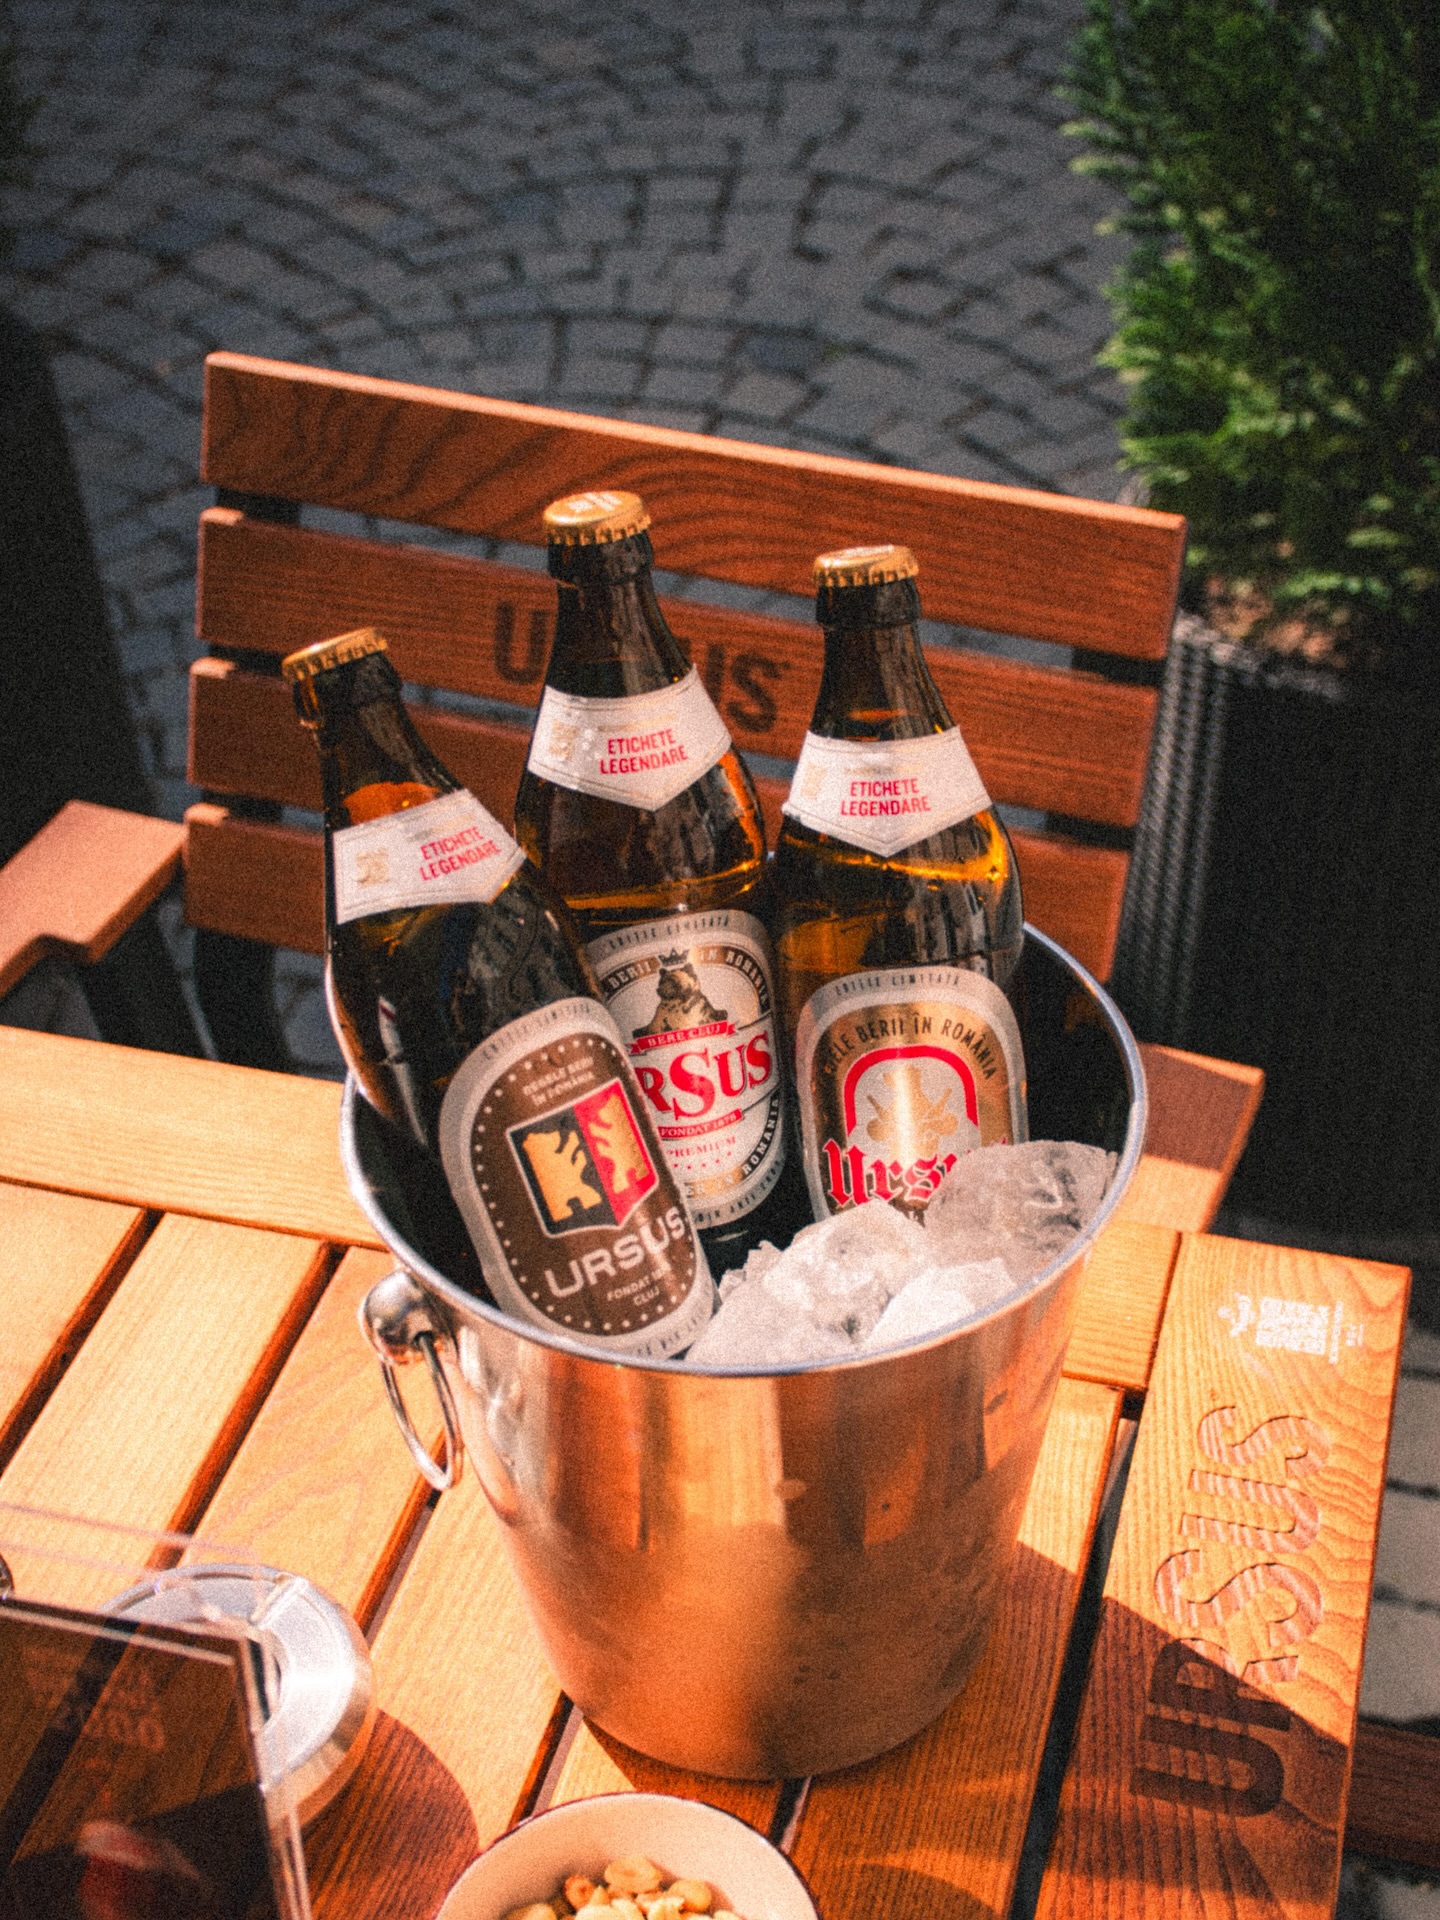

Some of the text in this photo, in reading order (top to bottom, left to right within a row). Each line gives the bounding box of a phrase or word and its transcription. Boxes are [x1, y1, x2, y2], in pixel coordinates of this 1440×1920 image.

[606, 727, 677, 756] ETICHETE
[600, 744, 689, 775] LEGENDARE
[850, 778, 920, 797] ETICHETE
[840, 796, 912, 817] LEGENDARE
[420, 826, 485, 861] ETICHETE
[419, 839, 503, 882] LEGENDARE
[647, 1024, 722, 1048] BERE CLUJ
[855, 1016, 904, 1042] BERII
[913, 1011, 933, 1034] ÎN
[940, 1017, 999, 1081] ROMÂNIA
[634, 1029, 772, 1121] RSUS
[823, 1138, 960, 1207] Urs
[543, 1206, 686, 1298] URSUS
[606, 1274, 651, 1301] FONDAT
[633, 1285, 661, 1307] CLUJ
[1129, 1405, 1331, 1818] URSUS
